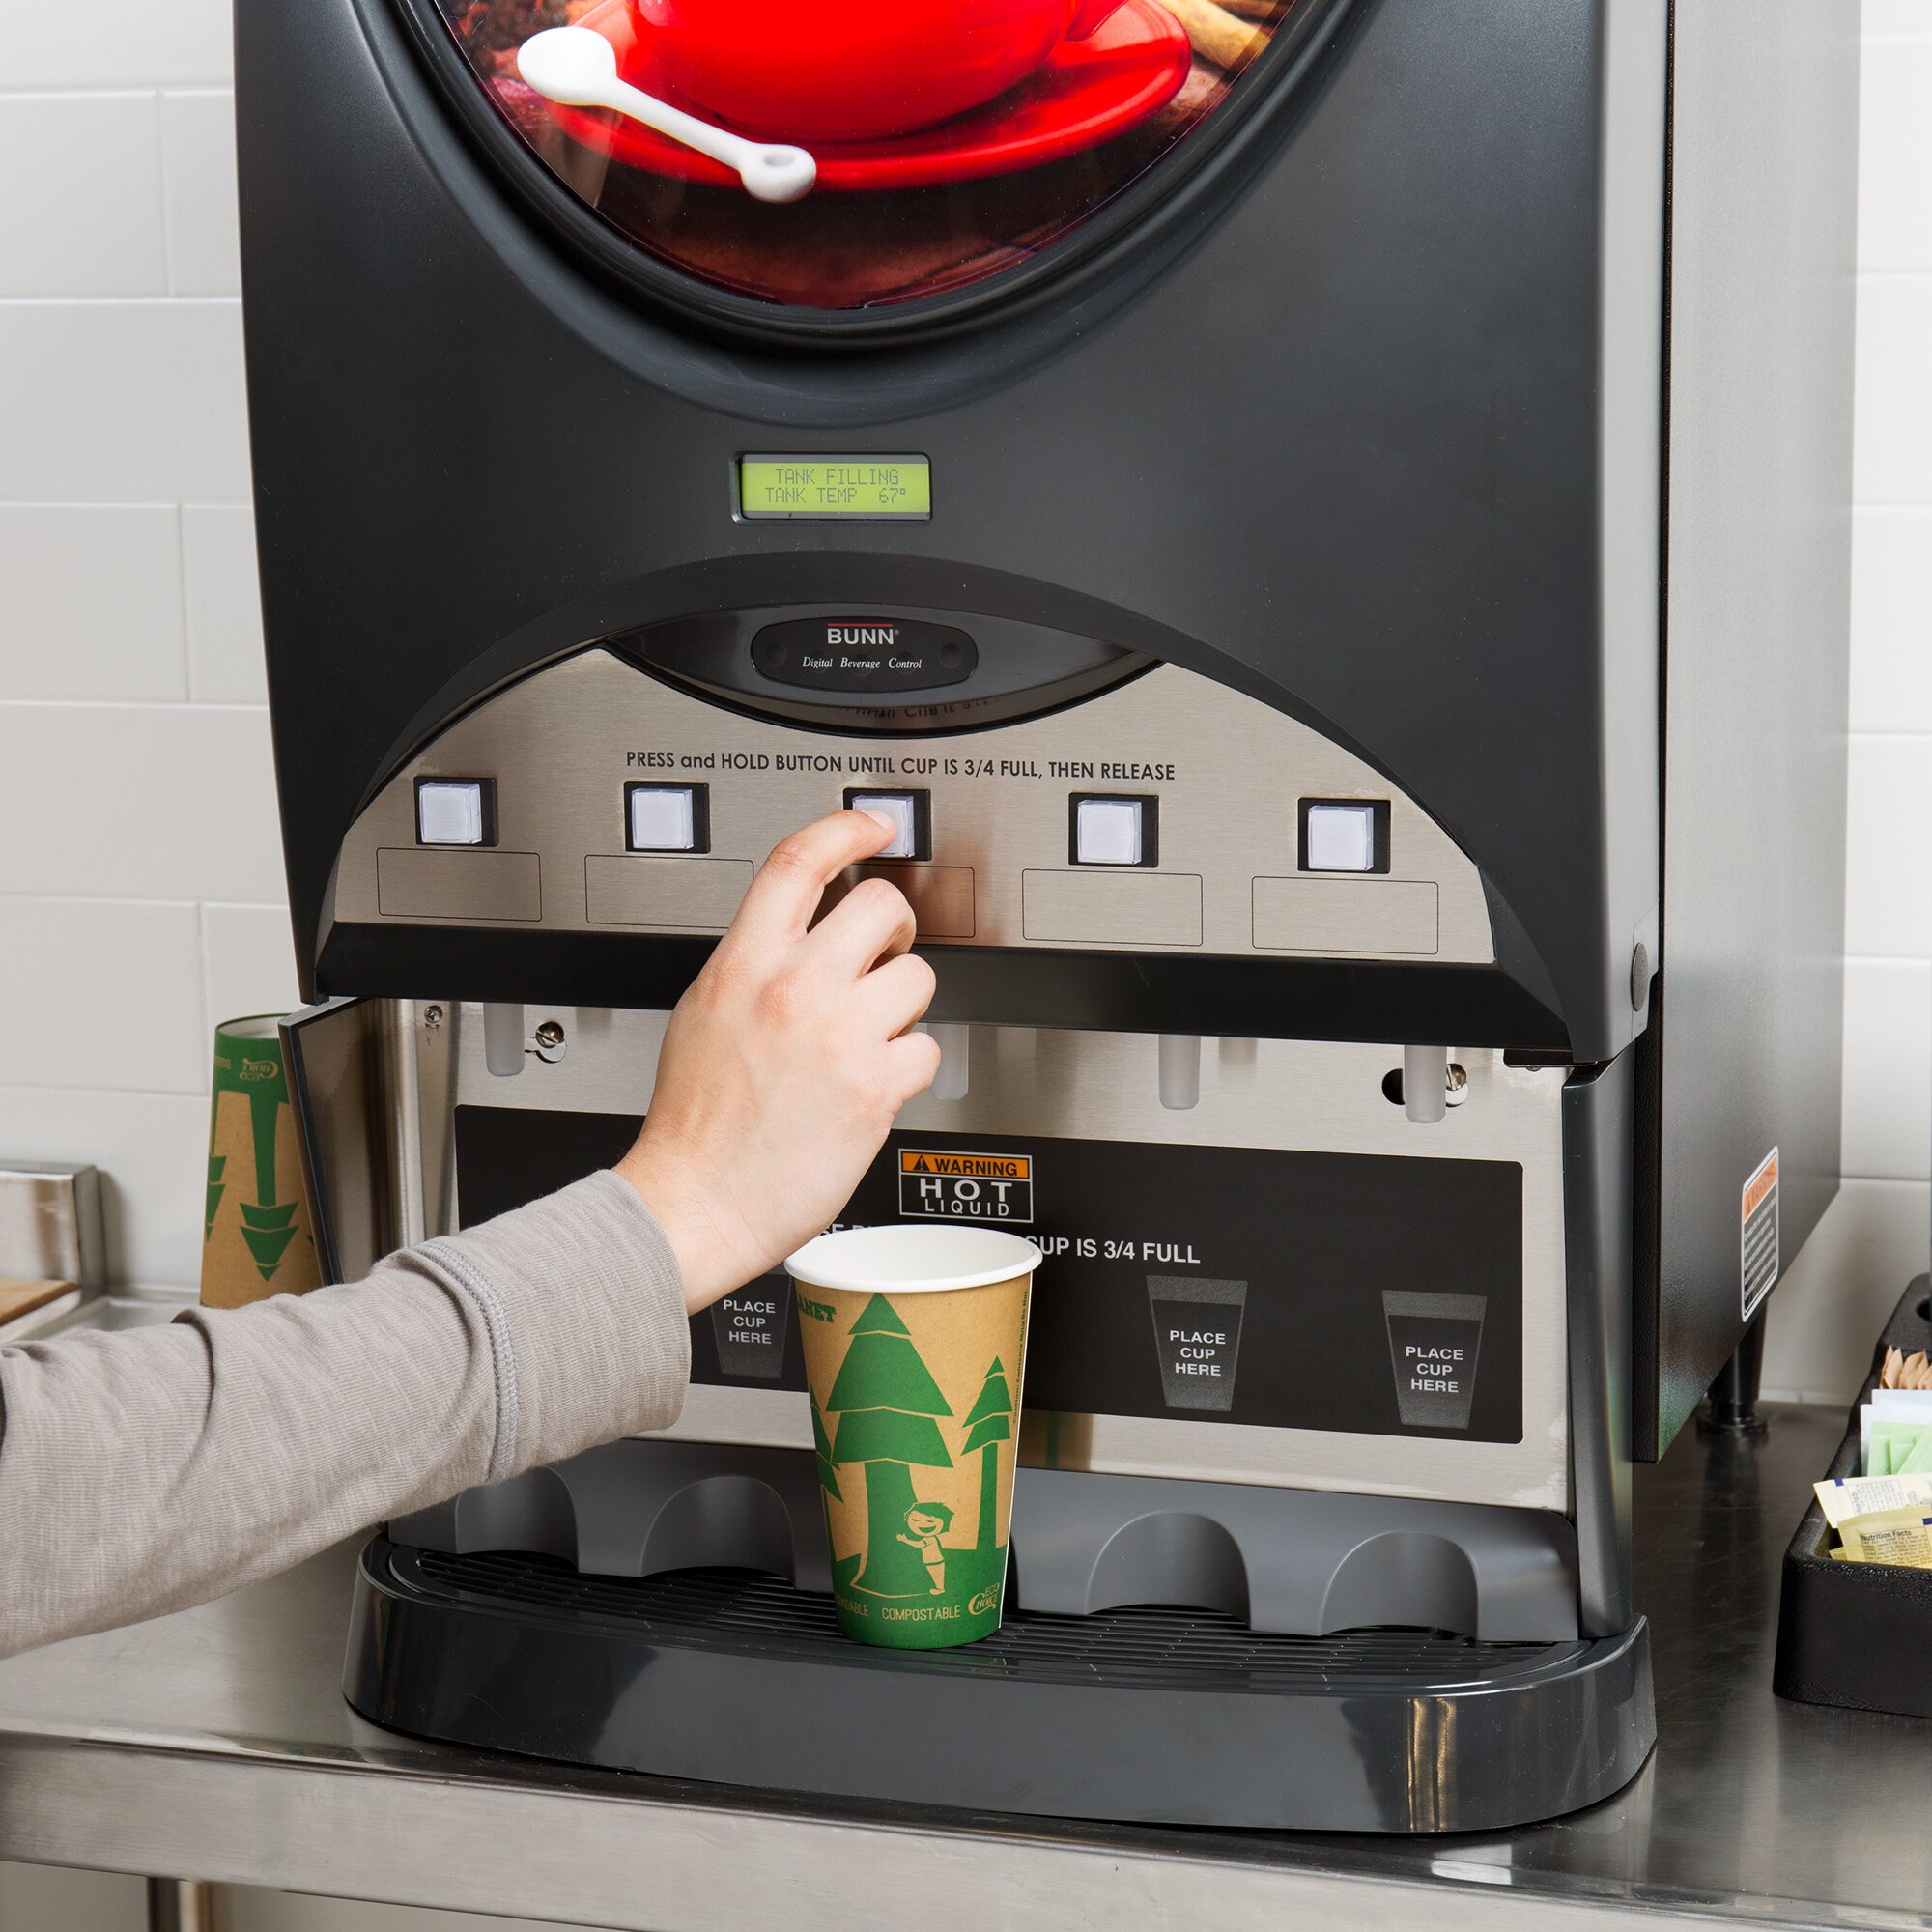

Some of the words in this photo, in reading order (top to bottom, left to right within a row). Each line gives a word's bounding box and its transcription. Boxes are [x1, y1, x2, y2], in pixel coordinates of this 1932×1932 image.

[775, 469, 815, 484] TANK
[827, 469, 899, 485] FILLING
[765, 487, 806, 503] TANK
[817, 487, 857, 503] TEMP
[802, 656, 833, 668] Digital
[840, 657, 881, 669] Beverage
[888, 658, 923, 668] Control
[626, 752, 675, 768] PRESS
[680, 753, 715, 769] and
[721, 753, 770, 770] HOLD
[776, 754, 842, 772] BUTTON
[848, 757, 895, 773] UNTIL
[901, 758, 938, 775] CUP
[944, 759, 958, 775] IS
[964, 759, 995, 778] 3/4
[1001, 760, 1043, 780] FULL,
[1048, 761, 1094, 778] THEN
[1100, 762, 1175, 781] RELEASE
[934, 1158, 1018, 1177] WARNING
[920, 1178, 1012, 1203] HOT
[924, 1198, 1009, 1217] LIQUID
[1076, 1238, 1097, 1258] IS
[1103, 1240, 1135, 1261] 3/4
[1143, 1242, 1201, 1264] FULL
[723, 1299, 776, 1314] PLACE
[733, 1316, 766, 1328] CUP
[728, 1331, 772, 1345] HERE
[1169, 1330, 1226, 1345] PLACE
[1179, 1347, 1215, 1360] CUP
[1406, 1346, 1464, 1361] PLACE
[1175, 1362, 1221, 1377] HERE
[1416, 1362, 1453, 1377] CUP
[1410, 1378, 1460, 1393] HERE
[1861, 1531, 1892, 1542] Nutrition
[1892, 1529, 1913, 1538] Facts
[881, 1605, 961, 1622] COMPOSTABLE
